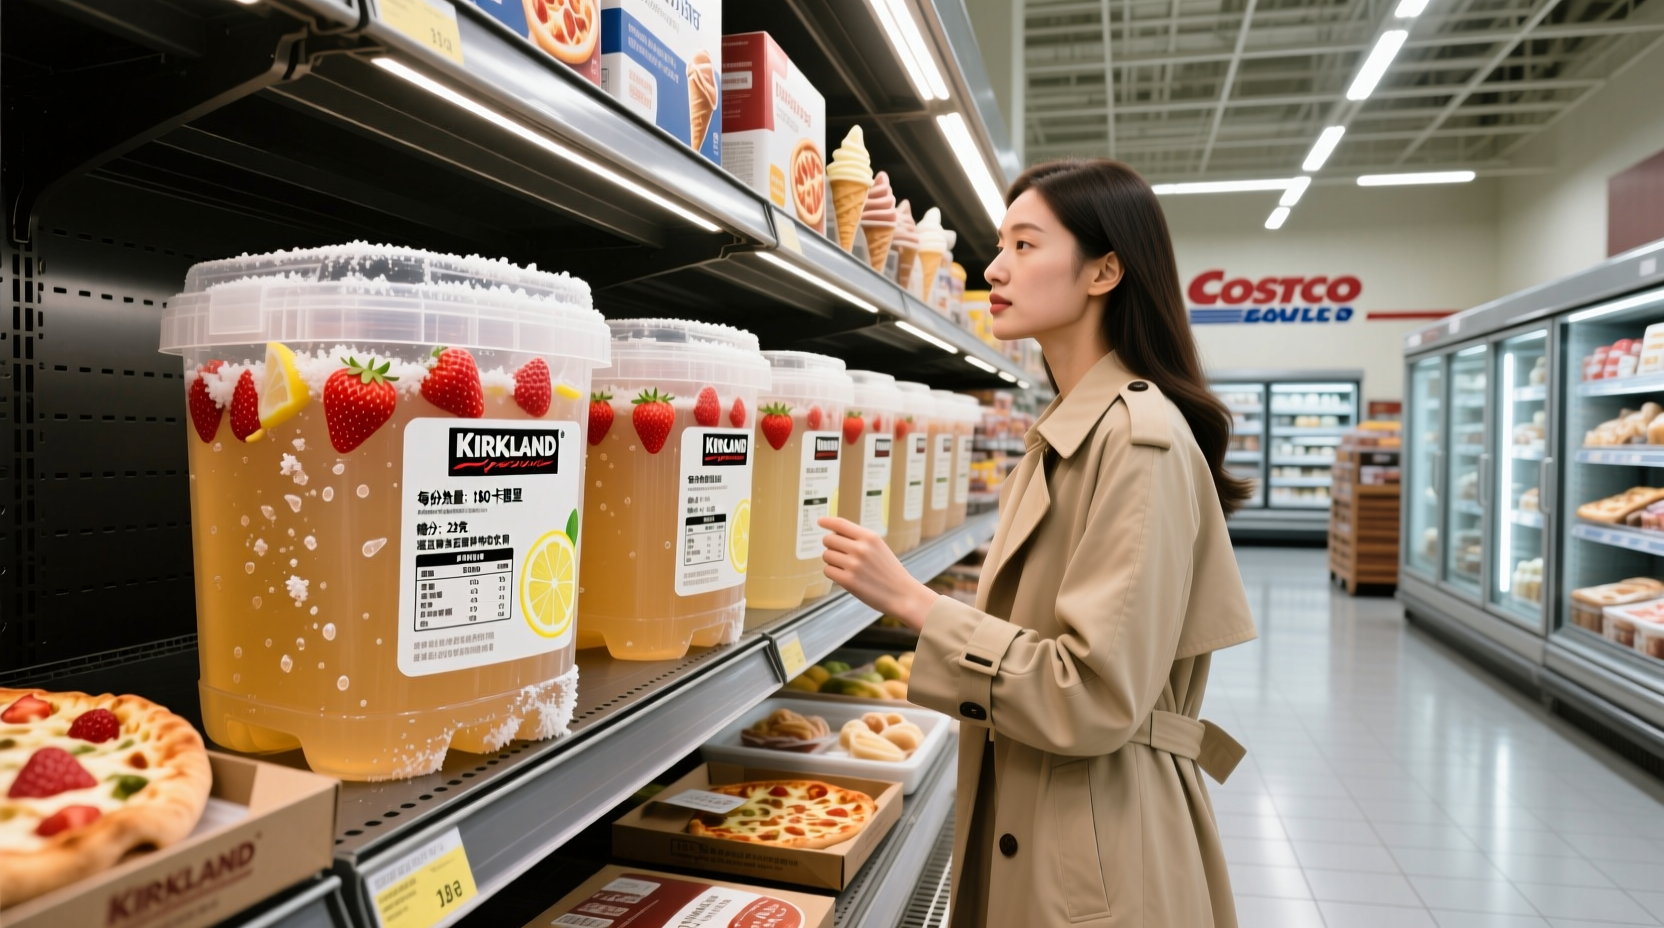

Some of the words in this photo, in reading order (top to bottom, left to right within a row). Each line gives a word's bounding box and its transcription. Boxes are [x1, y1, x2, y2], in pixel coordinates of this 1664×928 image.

[1188, 269, 1362, 305] COSTCO
[456, 432, 557, 458] KIRKLAND
[107, 841, 256, 927] KIRKLAND
